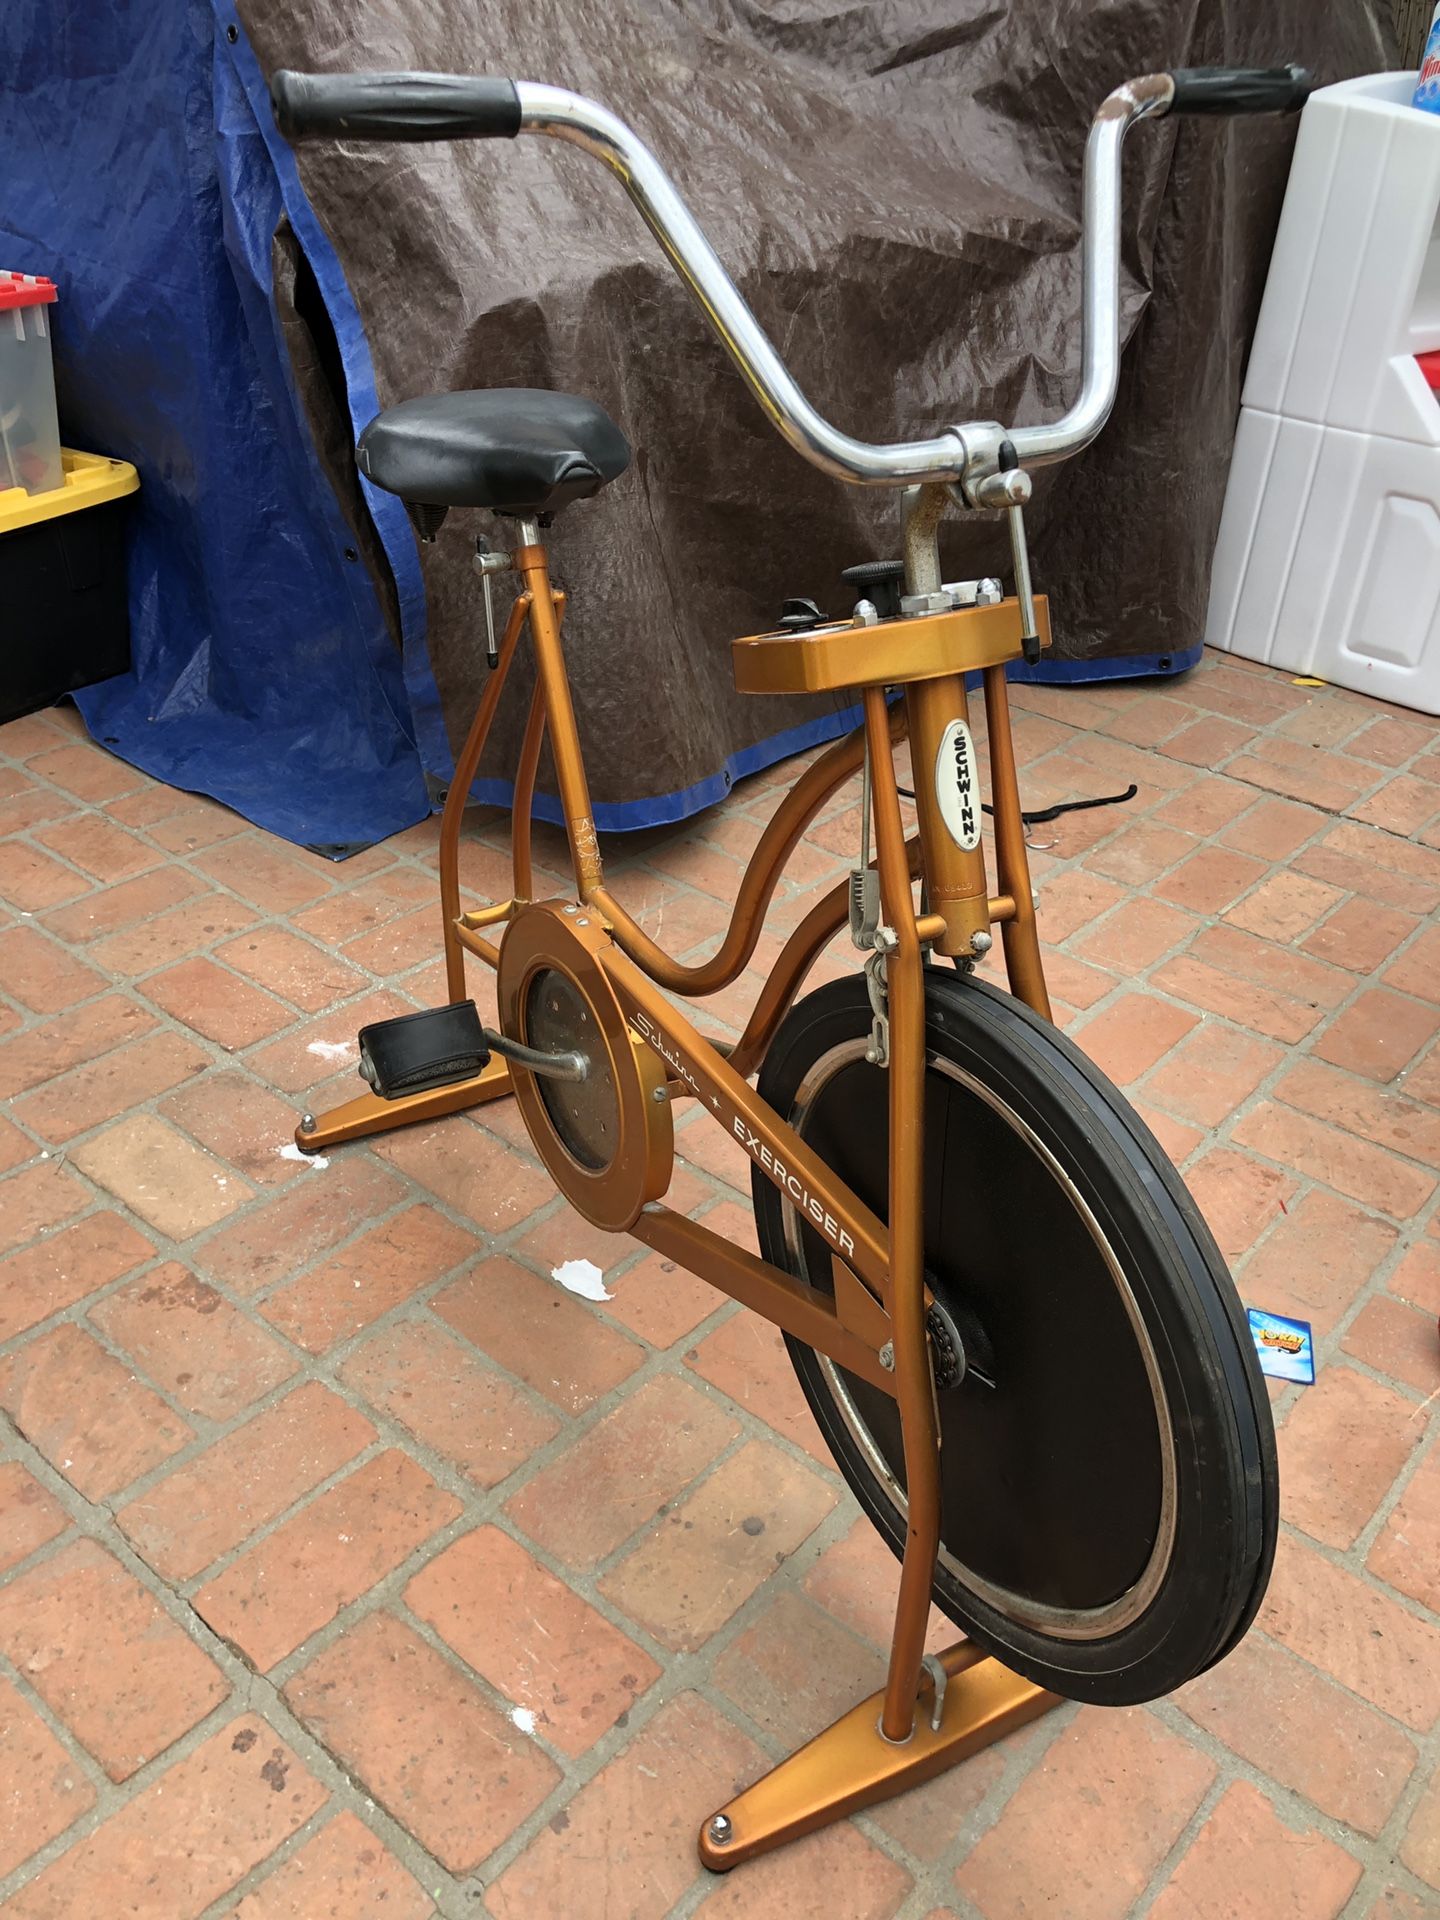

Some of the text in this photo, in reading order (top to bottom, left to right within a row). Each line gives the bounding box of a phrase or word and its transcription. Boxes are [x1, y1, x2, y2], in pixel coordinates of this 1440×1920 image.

[953, 736, 975, 836] SCHWINN
[629, 1012, 854, 1259] Schwinn EXERCISER
